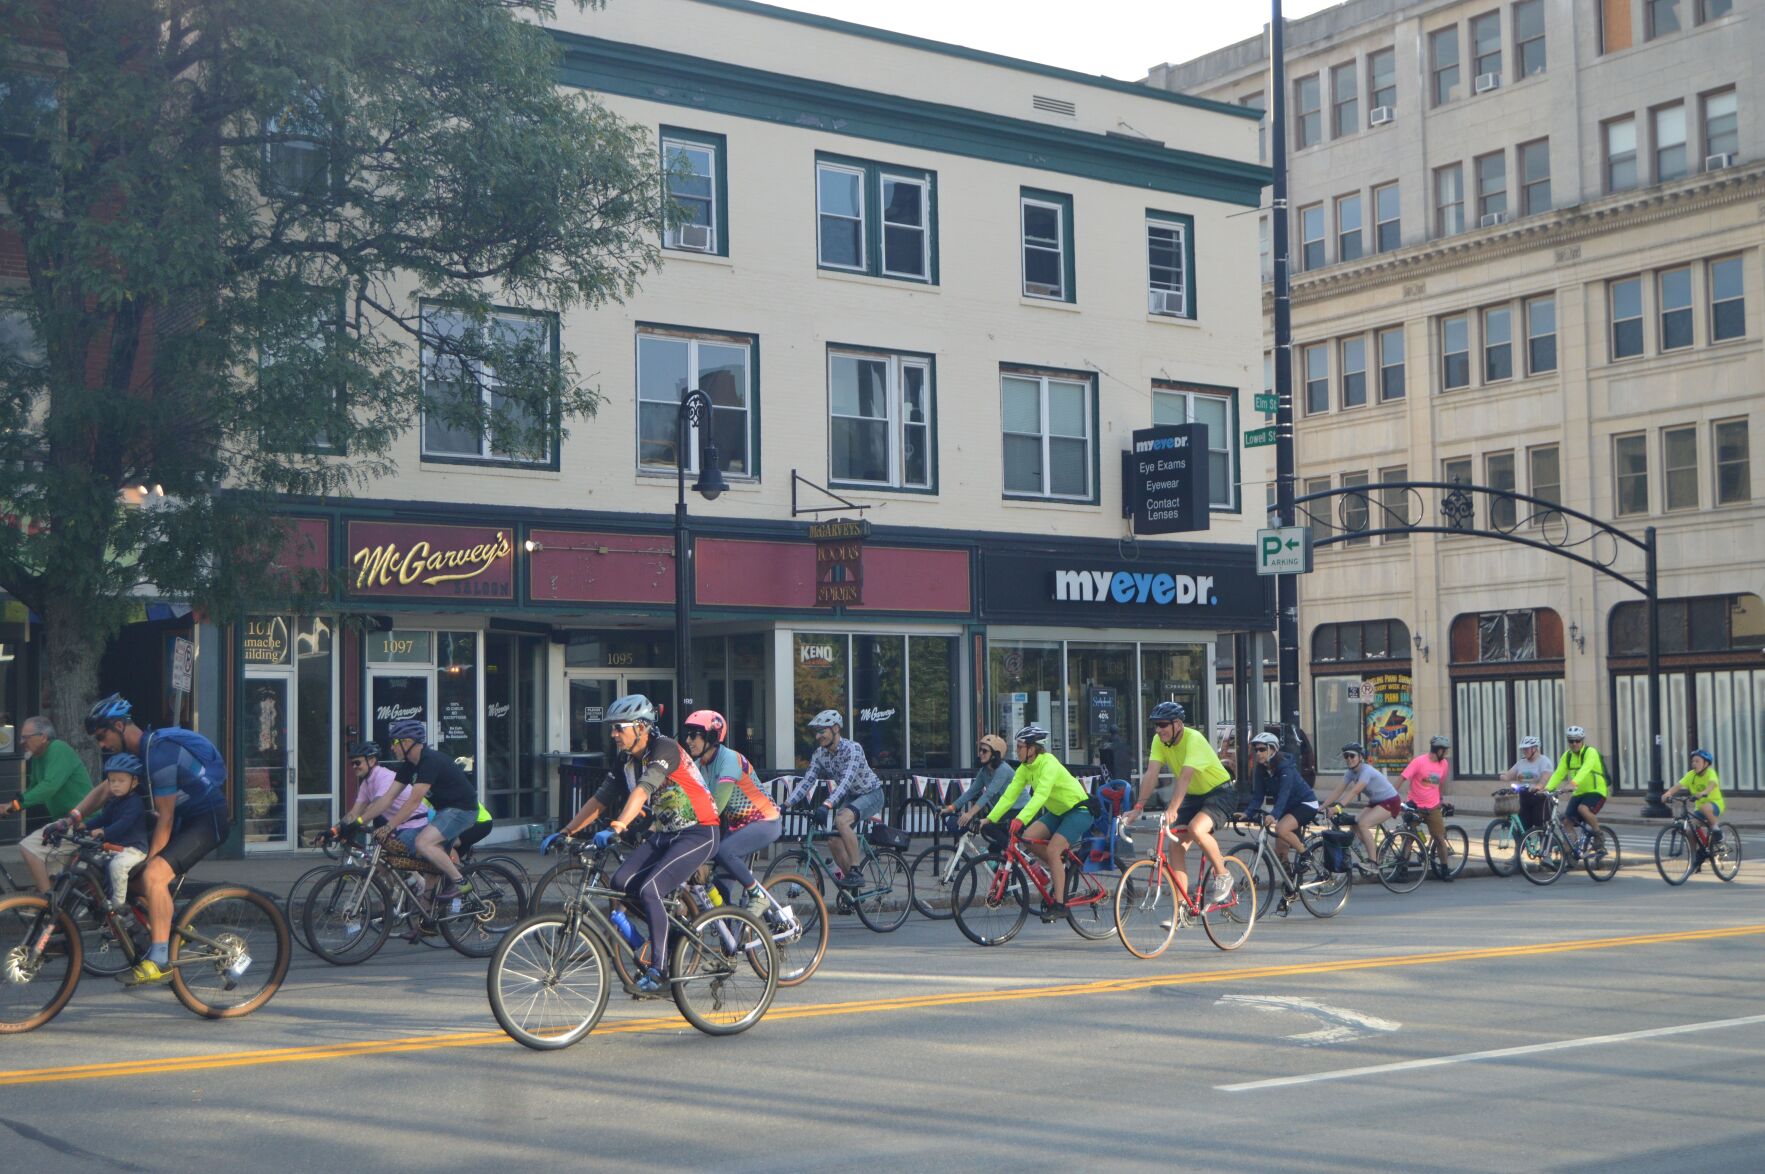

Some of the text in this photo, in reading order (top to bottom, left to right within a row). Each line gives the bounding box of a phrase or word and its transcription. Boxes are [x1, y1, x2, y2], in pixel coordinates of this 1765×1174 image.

[1255, 397, 1278, 410] Elm St
[1245, 430, 1277, 445] Lowell St
[1140, 460, 1186, 475] Eye Exams
[1146, 480, 1179, 492] Eyewear
[1146, 498, 1180, 510] Contact
[1148, 509, 1179, 520] Lenses
[454, 581, 509, 595] SALOON
[383, 640, 413, 653] 1097
[608, 653, 633, 665] 1095
[800, 645, 832, 663] KENO
